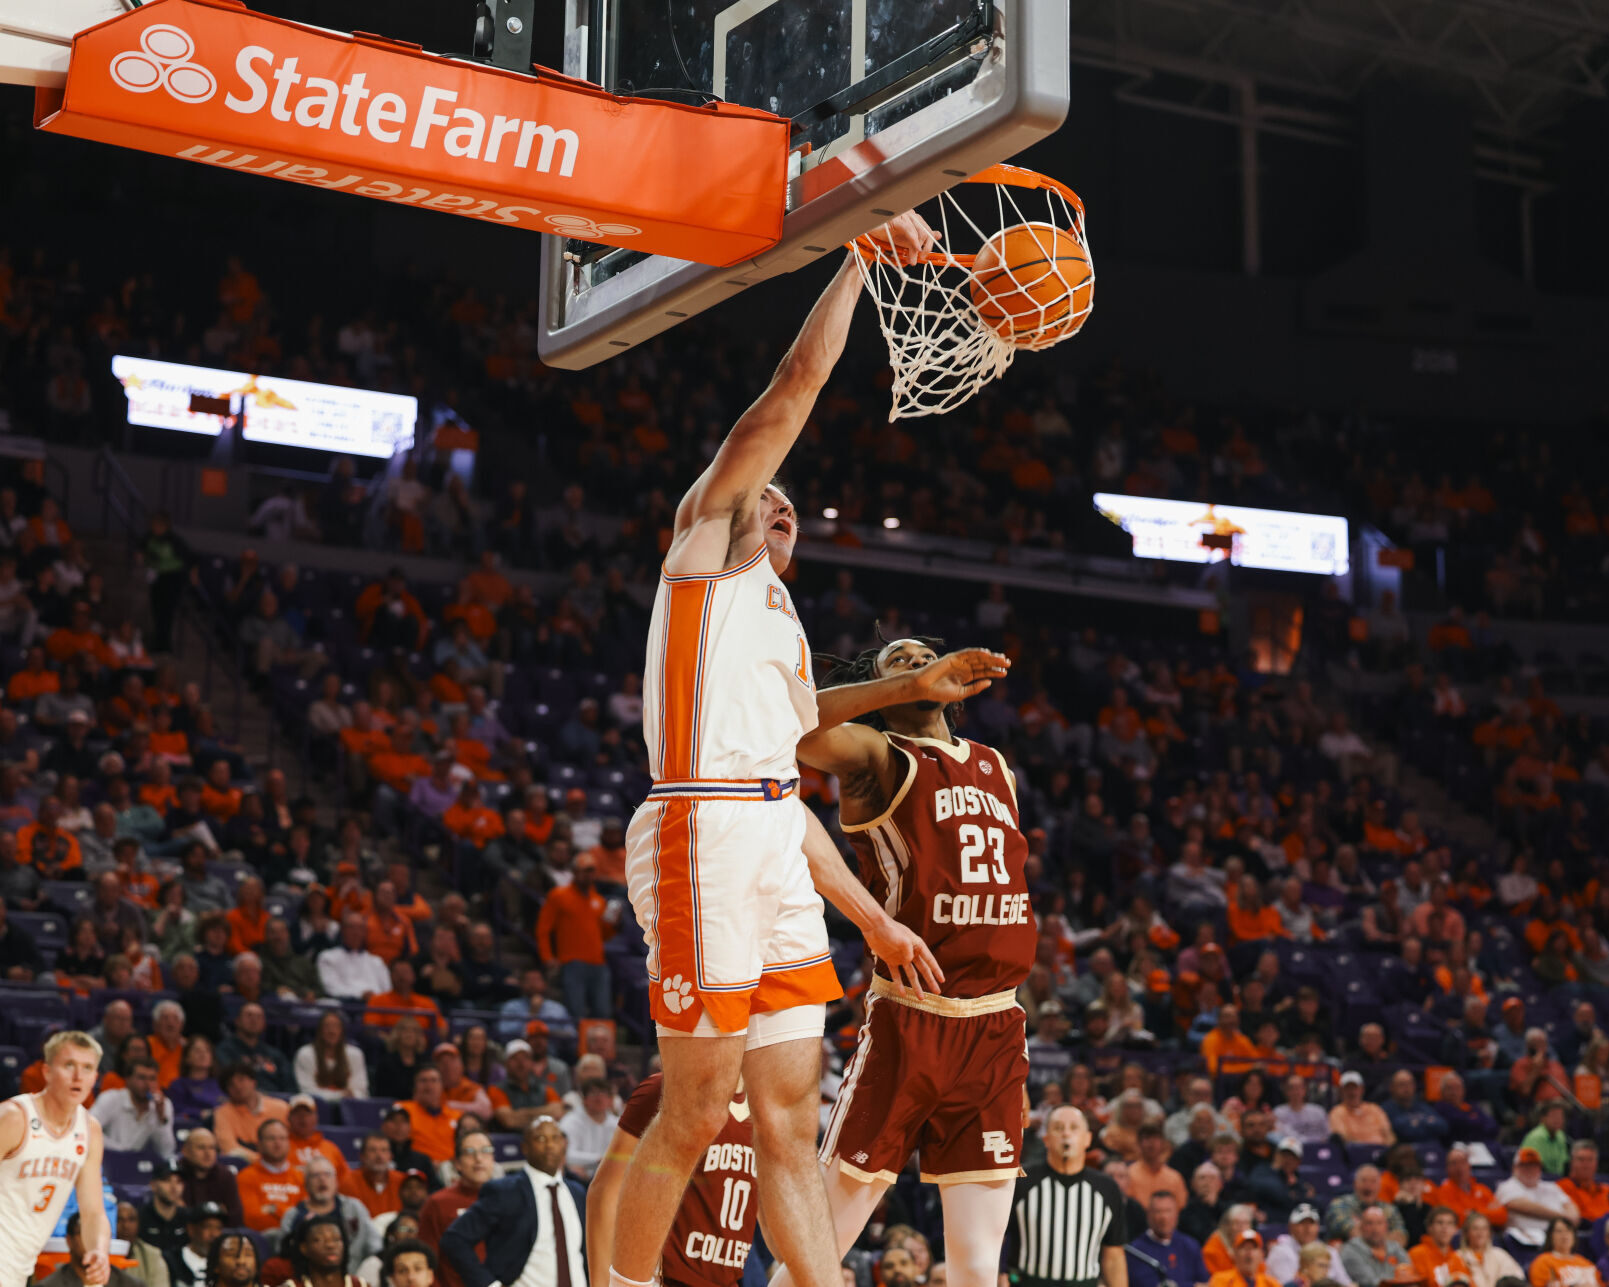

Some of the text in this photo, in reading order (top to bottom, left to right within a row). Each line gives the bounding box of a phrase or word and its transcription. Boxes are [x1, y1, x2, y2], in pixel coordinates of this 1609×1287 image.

[224, 45, 580, 178] State Farm
[175, 144, 542, 223] State Farm
[766, 584, 799, 624] CL
[935, 785, 1018, 831] BOSTON
[958, 823, 1011, 885] 23
[933, 892, 1029, 926] COLLEGE
[33, 1184, 56, 1213] 3
[719, 1177, 752, 1232] 10
